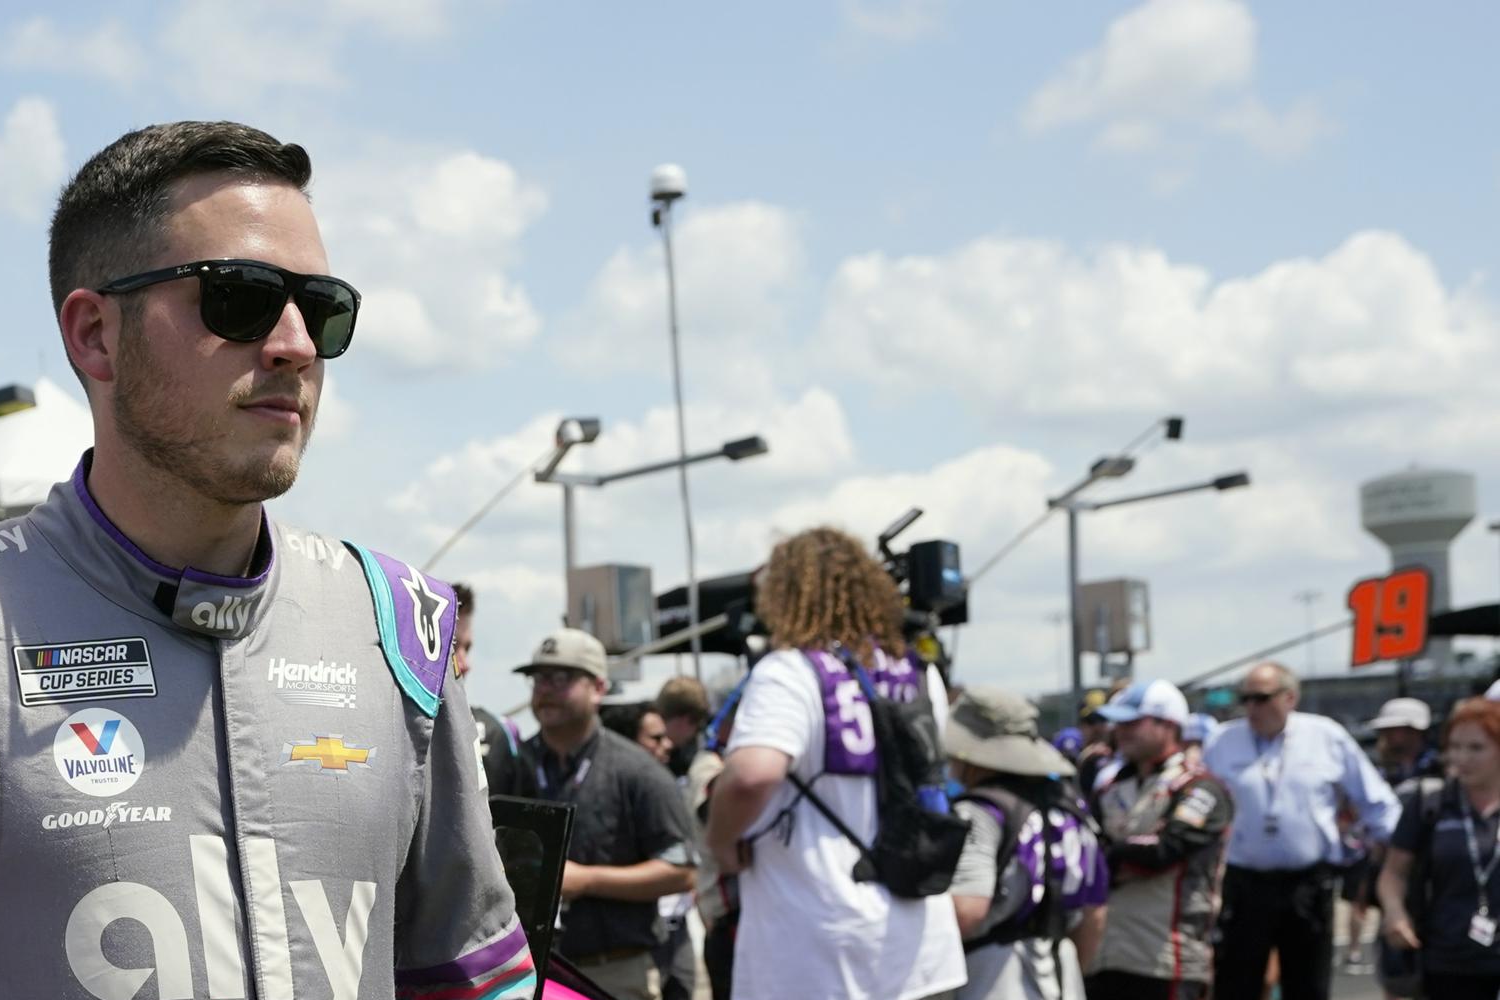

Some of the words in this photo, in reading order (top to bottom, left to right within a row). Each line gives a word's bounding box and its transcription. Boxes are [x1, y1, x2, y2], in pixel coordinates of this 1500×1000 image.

[287, 534, 347, 571] ally
[191, 595, 252, 638] ally
[1348, 567, 1431, 668] 19
[59, 644, 127, 666] NASCAR
[40, 675, 72, 690] CUP
[76, 669, 134, 688] SERIES
[268, 658, 357, 688] Hendrick
[286, 682, 357, 693] MOTORSPORTS
[63, 753, 136, 779] VALVOLINE
[42, 802, 172, 830] GOODYEAR
